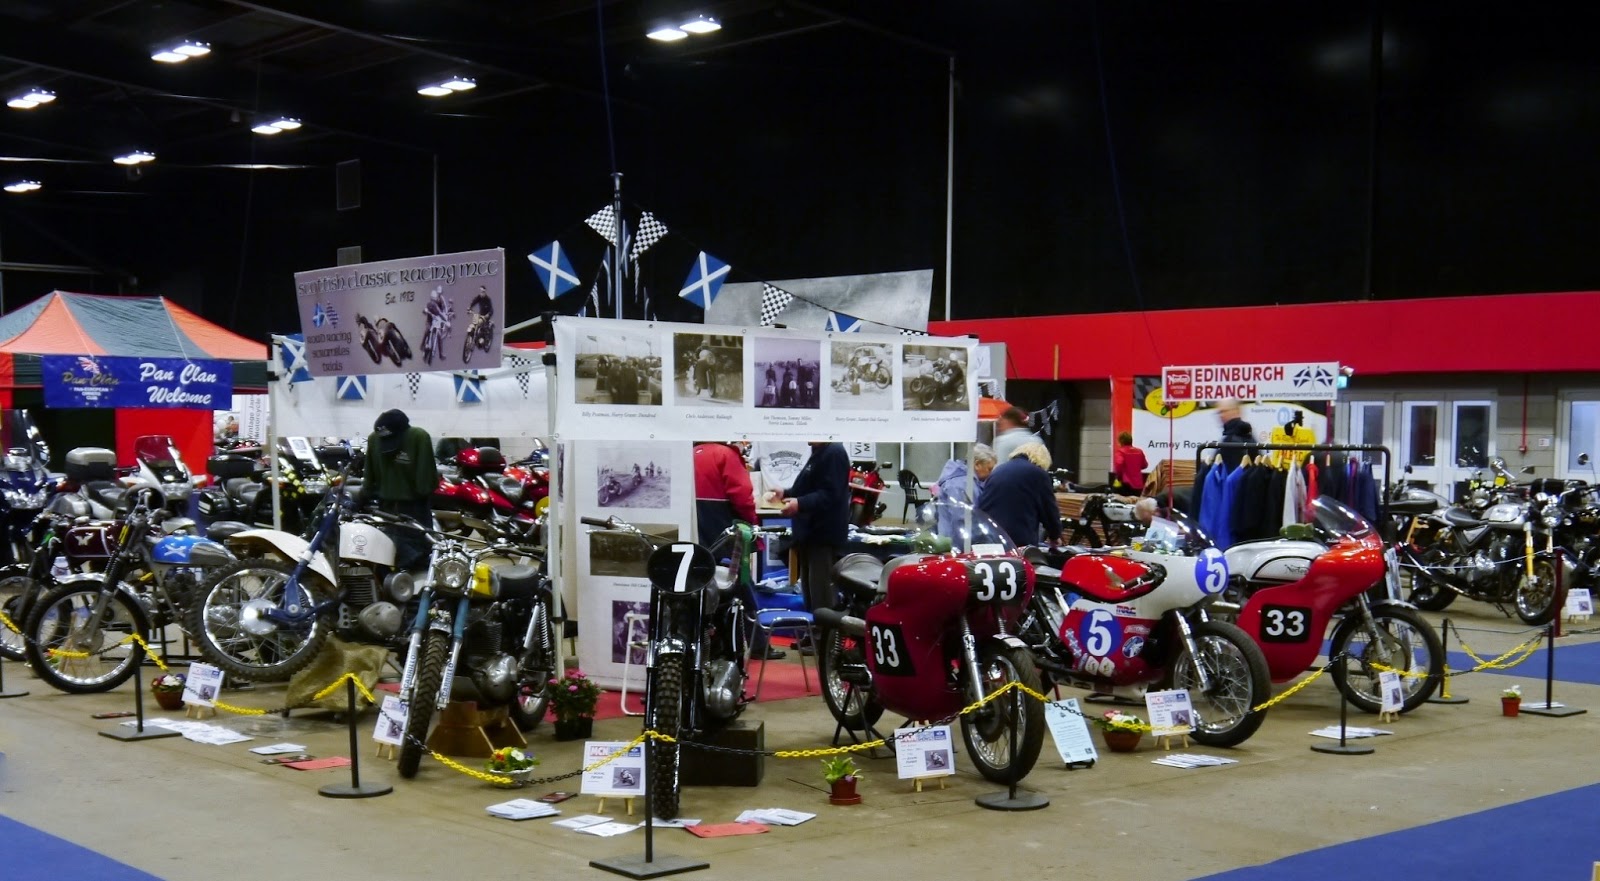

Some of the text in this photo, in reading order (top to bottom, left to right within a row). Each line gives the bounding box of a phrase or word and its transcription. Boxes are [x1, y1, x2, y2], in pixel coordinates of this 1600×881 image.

[139, 362, 217, 385] Pan Clan
[1195, 366, 1284, 383] EDINBURGH
[146, 385, 212, 405] Welcome
[1195, 384, 1257, 399] BRANCH
[671, 544, 694, 592] 7
[974, 561, 1018, 601] 33
[1205, 548, 1227, 593] 5
[1086, 610, 1113, 657] 5
[1266, 609, 1304, 636] 33
[872, 625, 900, 668] 33
